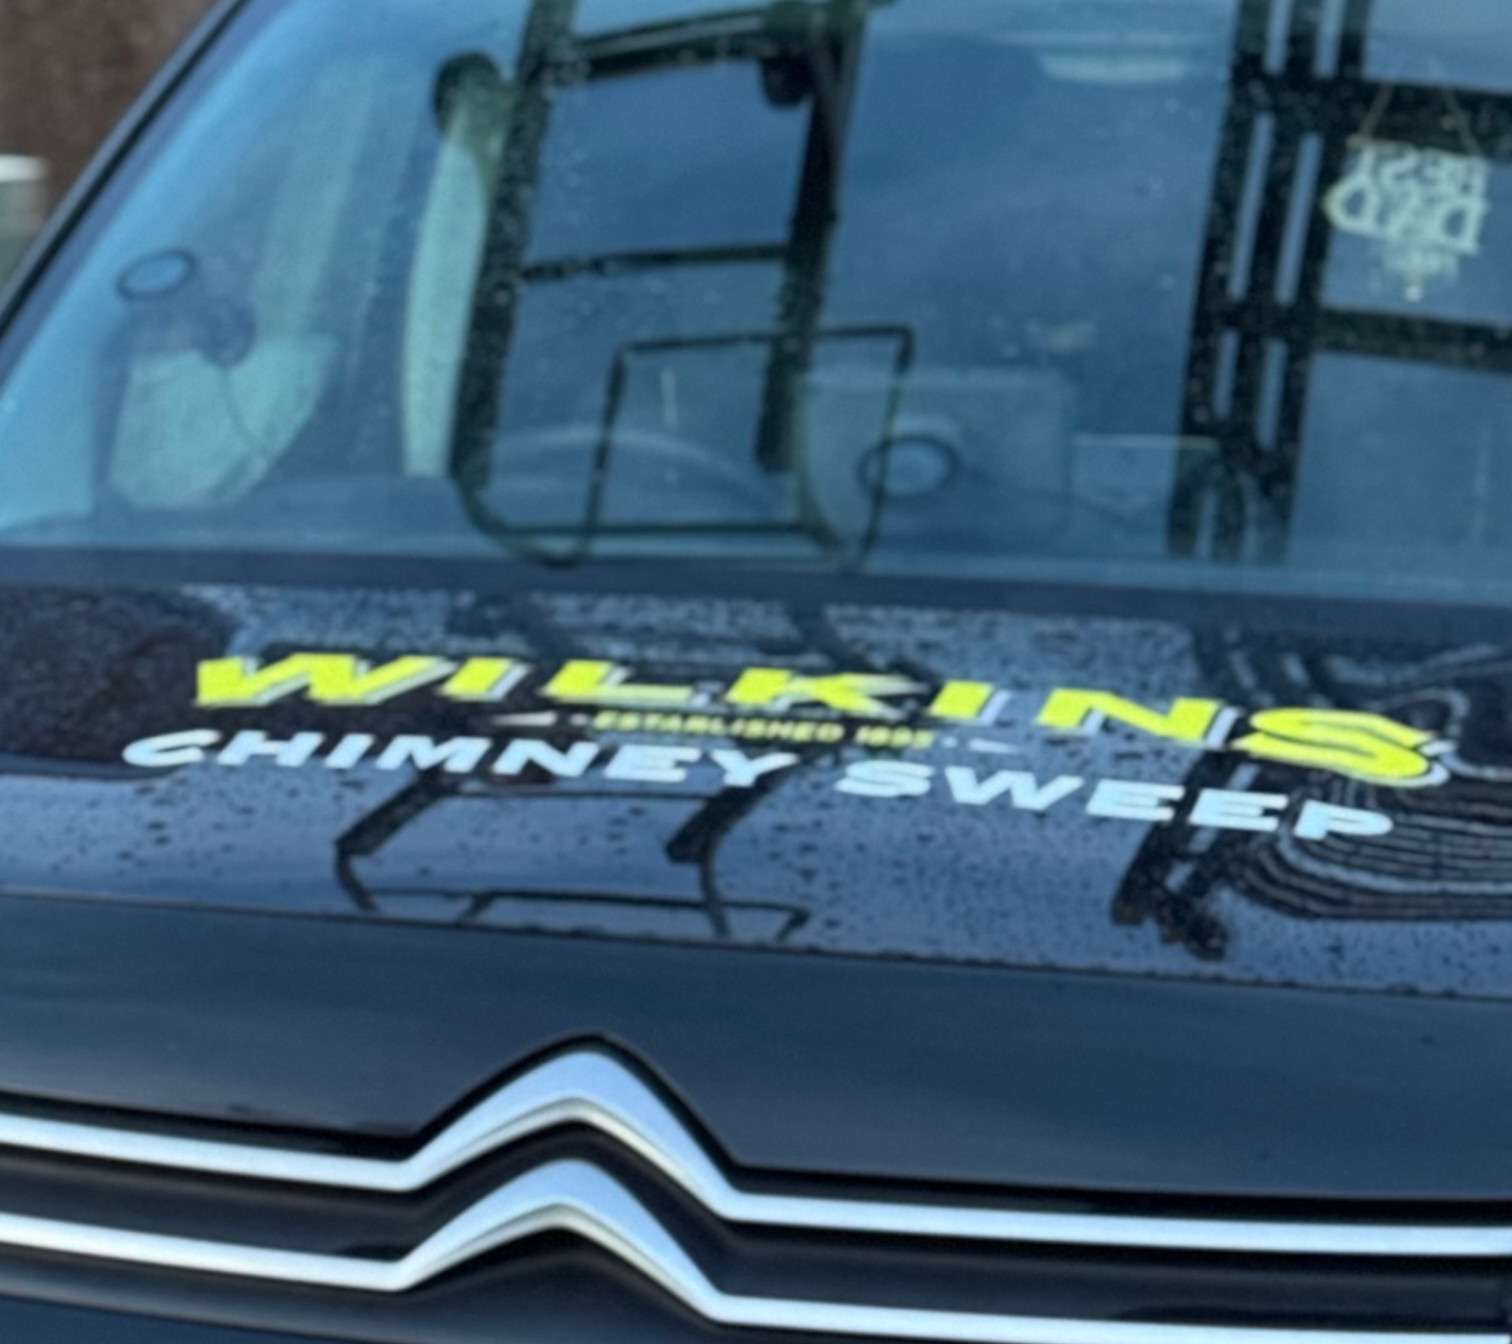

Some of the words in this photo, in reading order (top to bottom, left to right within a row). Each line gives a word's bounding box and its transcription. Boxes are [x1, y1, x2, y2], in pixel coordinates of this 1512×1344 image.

[195, 653, 1448, 787] WILKINS
[593, 710, 844, 743] ESTABLISHED
[122, 729, 799, 786] CHIMNEY
[835, 760, 1393, 839] SWEEP
